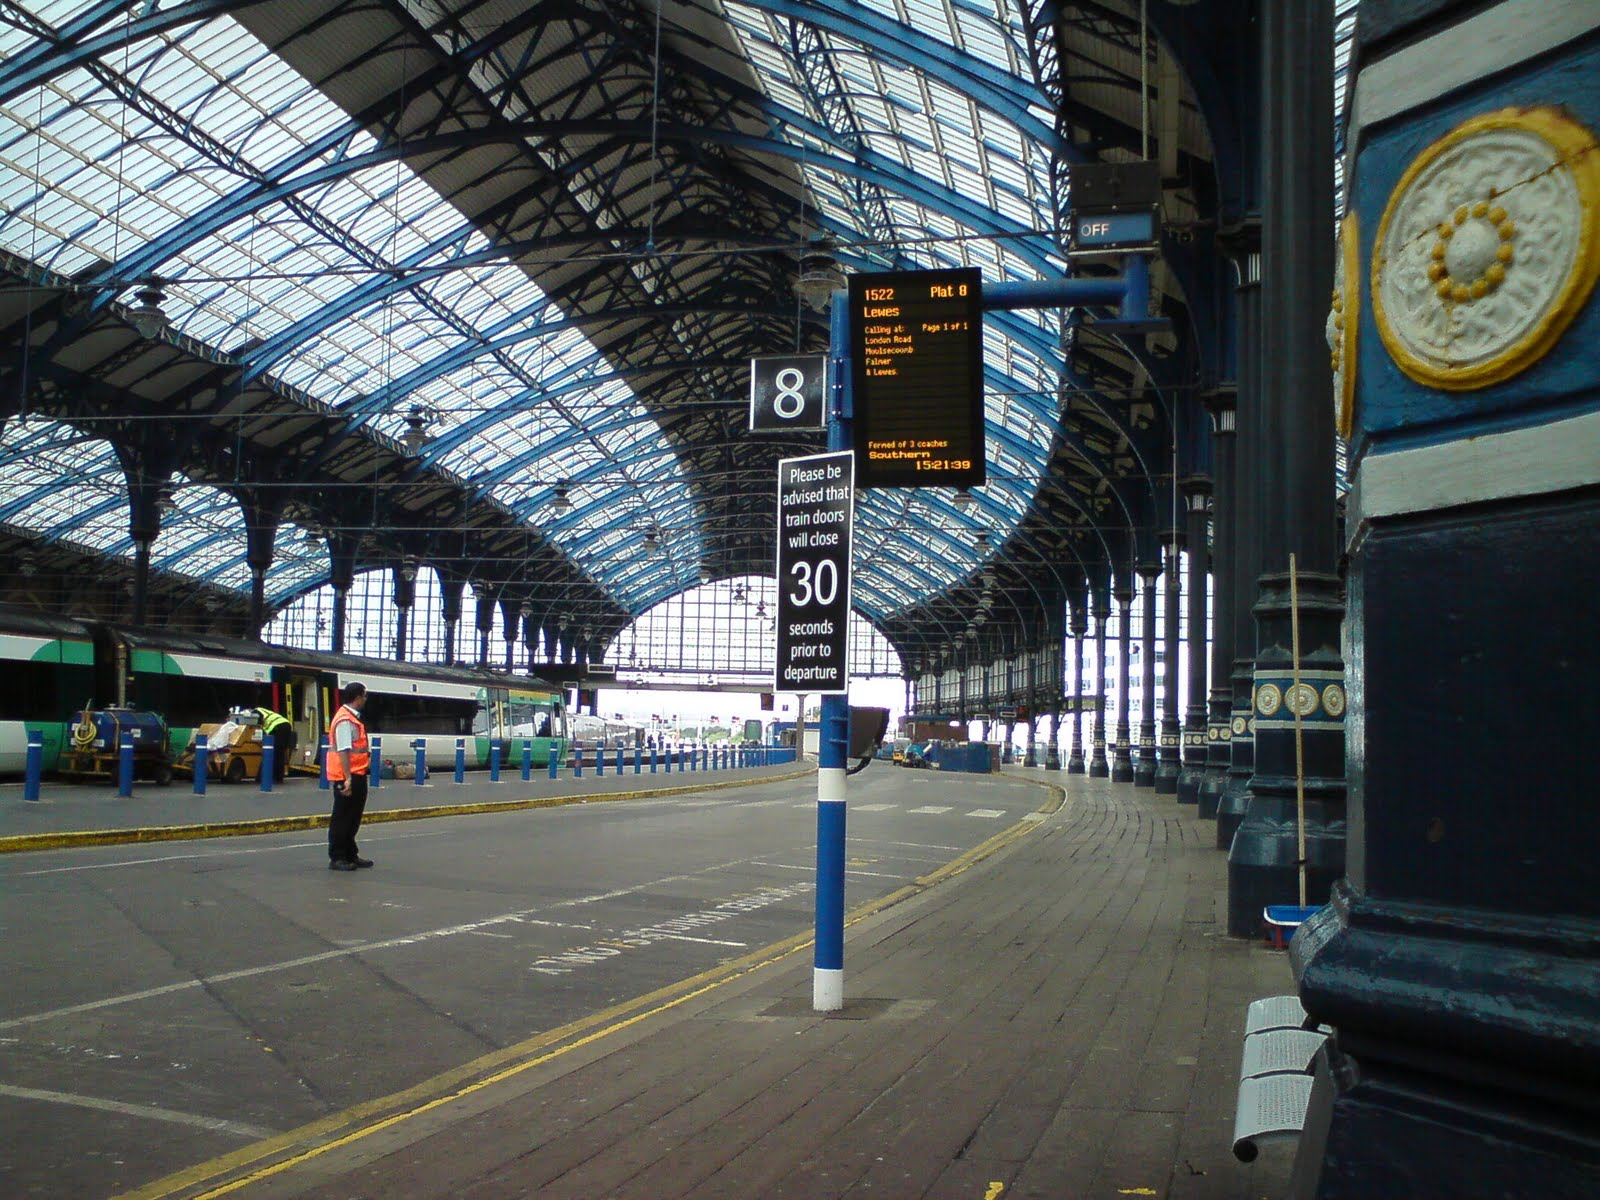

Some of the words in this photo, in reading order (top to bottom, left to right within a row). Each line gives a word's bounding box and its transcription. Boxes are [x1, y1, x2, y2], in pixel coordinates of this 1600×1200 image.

[1081, 223, 1110, 237] OFF
[864, 288, 895, 301] 1522
[930, 285, 955, 298] Plat
[958, 285, 968, 297] 8
[863, 306, 900, 318] Lewes
[864, 325, 892, 335] Calling
[922, 323, 941, 334] Page
[943, 322, 949, 331] 1
[950, 322, 961, 331] of
[963, 321, 968, 330] 1
[864, 336, 892, 345] London
[893, 335, 912, 344] Road
[865, 357, 892, 366] Falmer
[773, 367, 805, 419] 8
[868, 440, 896, 450] Formed
[897, 440, 907, 449] of
[909, 440, 916, 448] 3
[917, 439, 948, 448] coaches
[869, 450, 931, 460] Southern
[916, 459, 971, 471] 15:21:39
[790, 467, 824, 484] Please
[826, 464, 842, 479] be
[782, 490, 823, 507] advised
[825, 485, 850, 502] that
[785, 512, 811, 528] train
[812, 508, 845, 525] doors
[788, 533, 808, 548] will
[810, 530, 839, 547] close
[789, 558, 838, 607] 30
[789, 618, 834, 636] seconds
[790, 642, 815, 662] prior
[816, 641, 832, 658] to
[784, 664, 838, 684] departure
